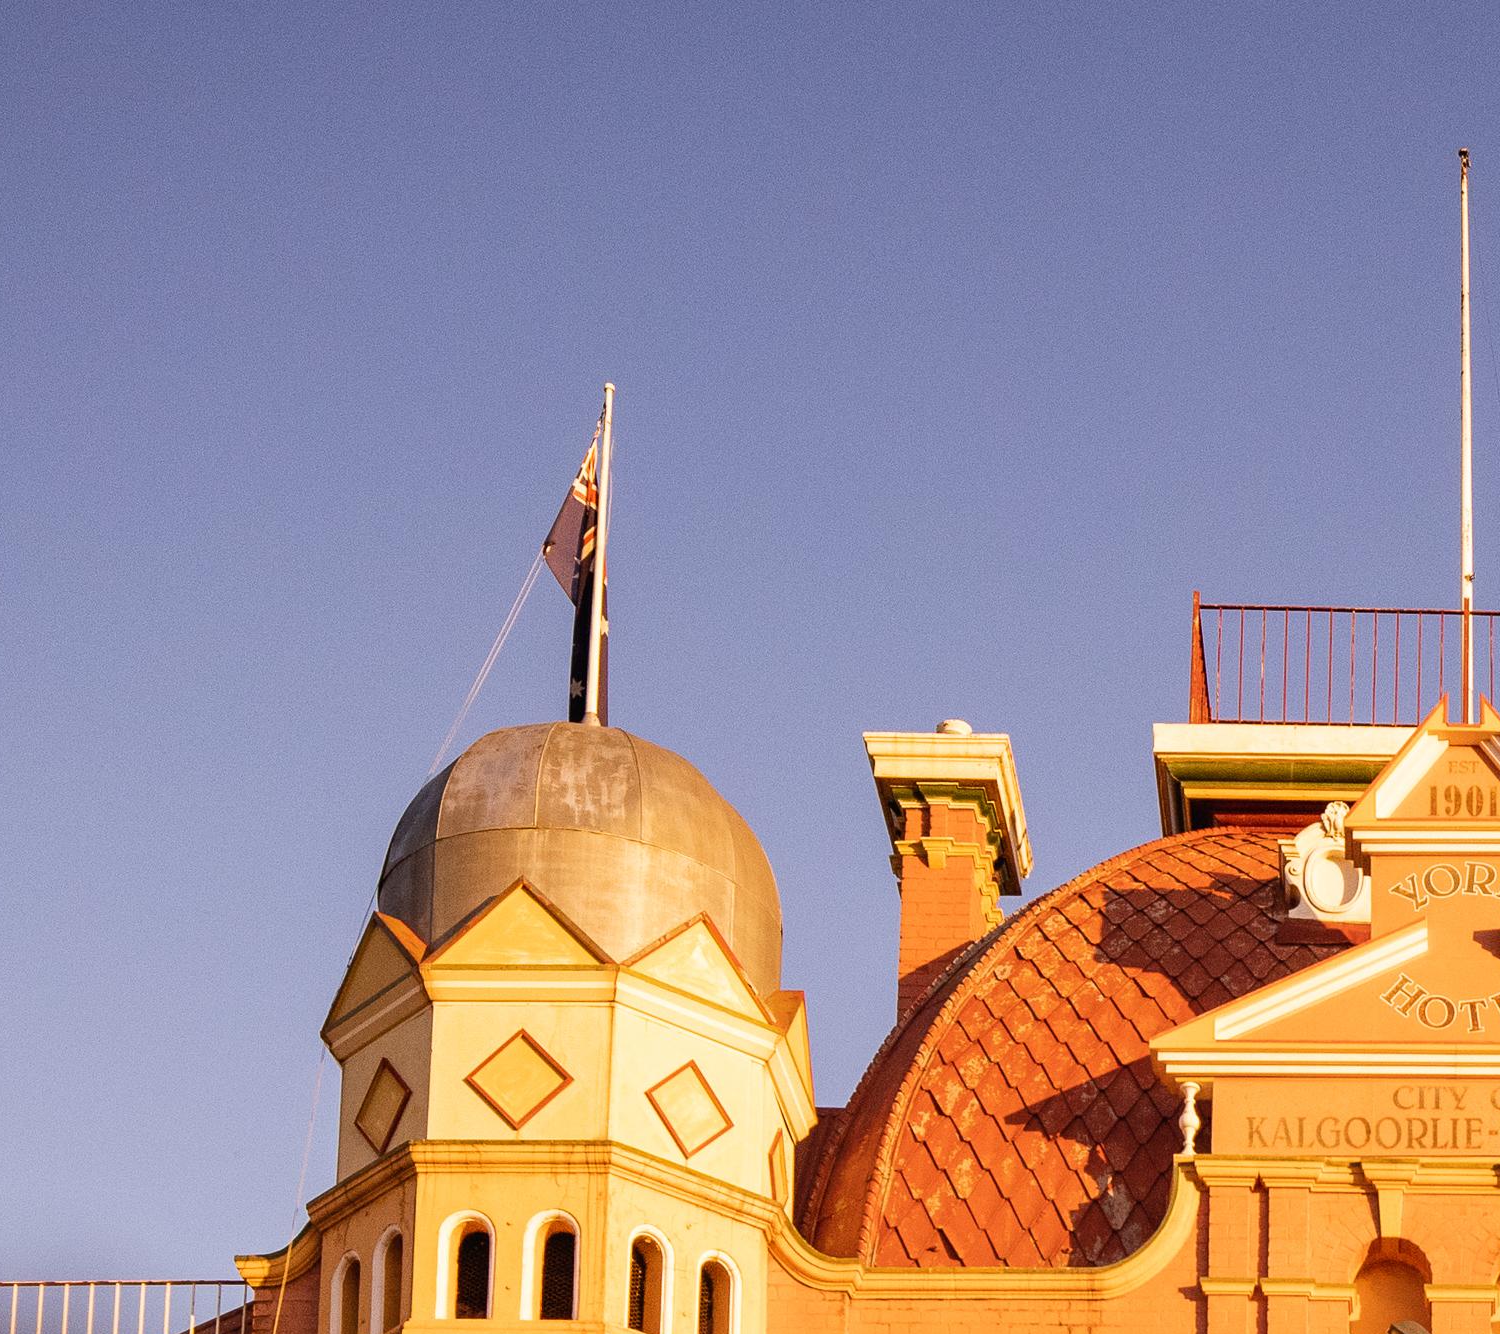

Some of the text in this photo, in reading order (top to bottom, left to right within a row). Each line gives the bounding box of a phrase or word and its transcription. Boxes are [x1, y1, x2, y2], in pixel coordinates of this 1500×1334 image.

[1448, 761, 1480, 774] EST
[1429, 785, 1500, 817] 1901
[1392, 1085, 1468, 1111] CITY
